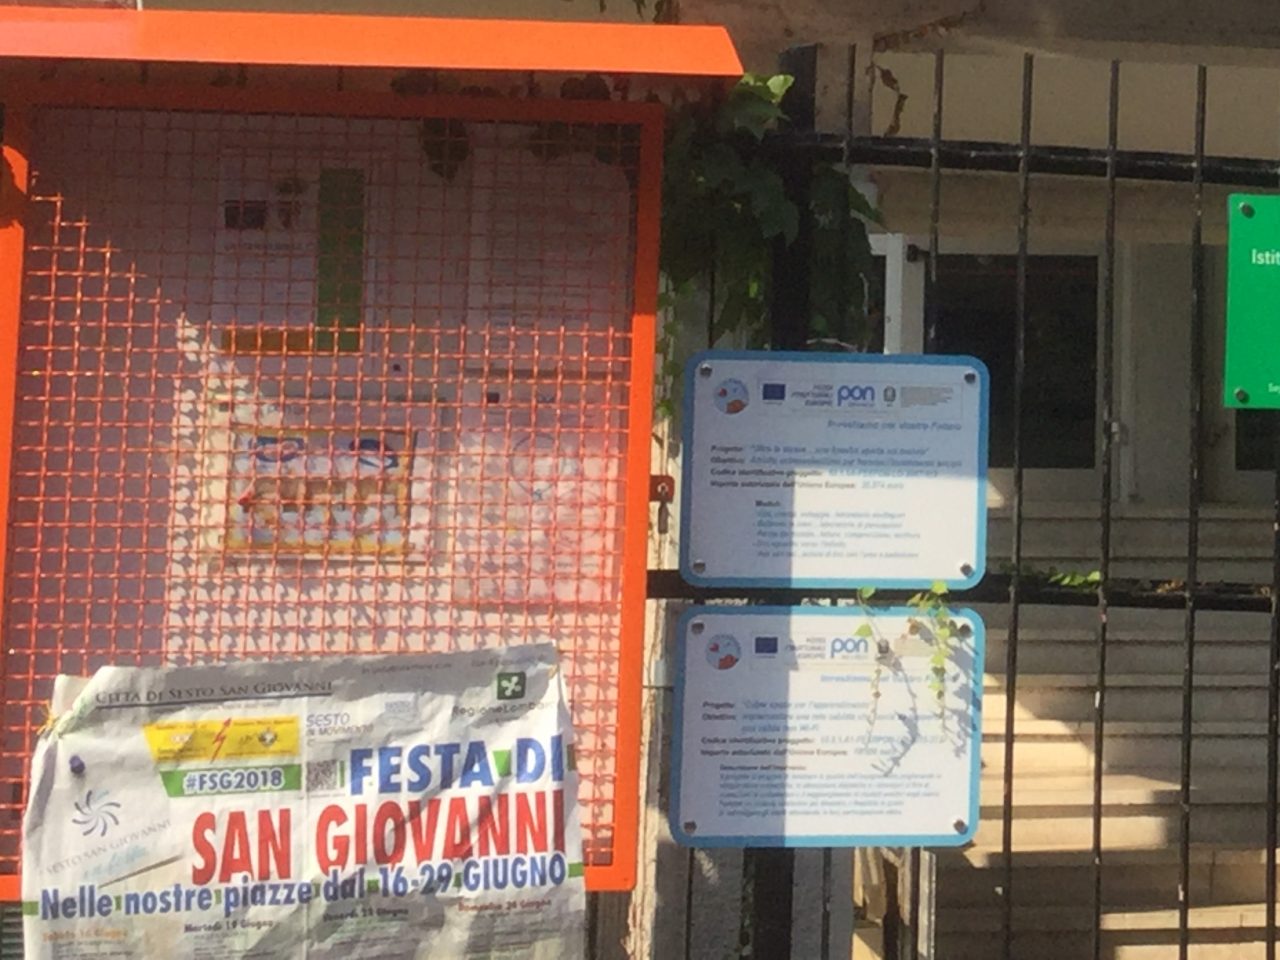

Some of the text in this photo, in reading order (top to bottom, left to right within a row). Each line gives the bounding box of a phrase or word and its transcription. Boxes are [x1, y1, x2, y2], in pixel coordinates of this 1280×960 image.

[837, 385, 875, 406] pon
[830, 637, 868, 658] pon
[306, 712, 350, 726] SESTO
[350, 740, 495, 795] FESTA
[516, 734, 564, 784] DI
[185, 771, 282, 789] #FSG2018
[192, 808, 291, 886] SAN
[316, 789, 565, 877] GIOVANNI
[41, 853, 566, 920] Nelle nostre piazze dal 16-29 GIUGNO
